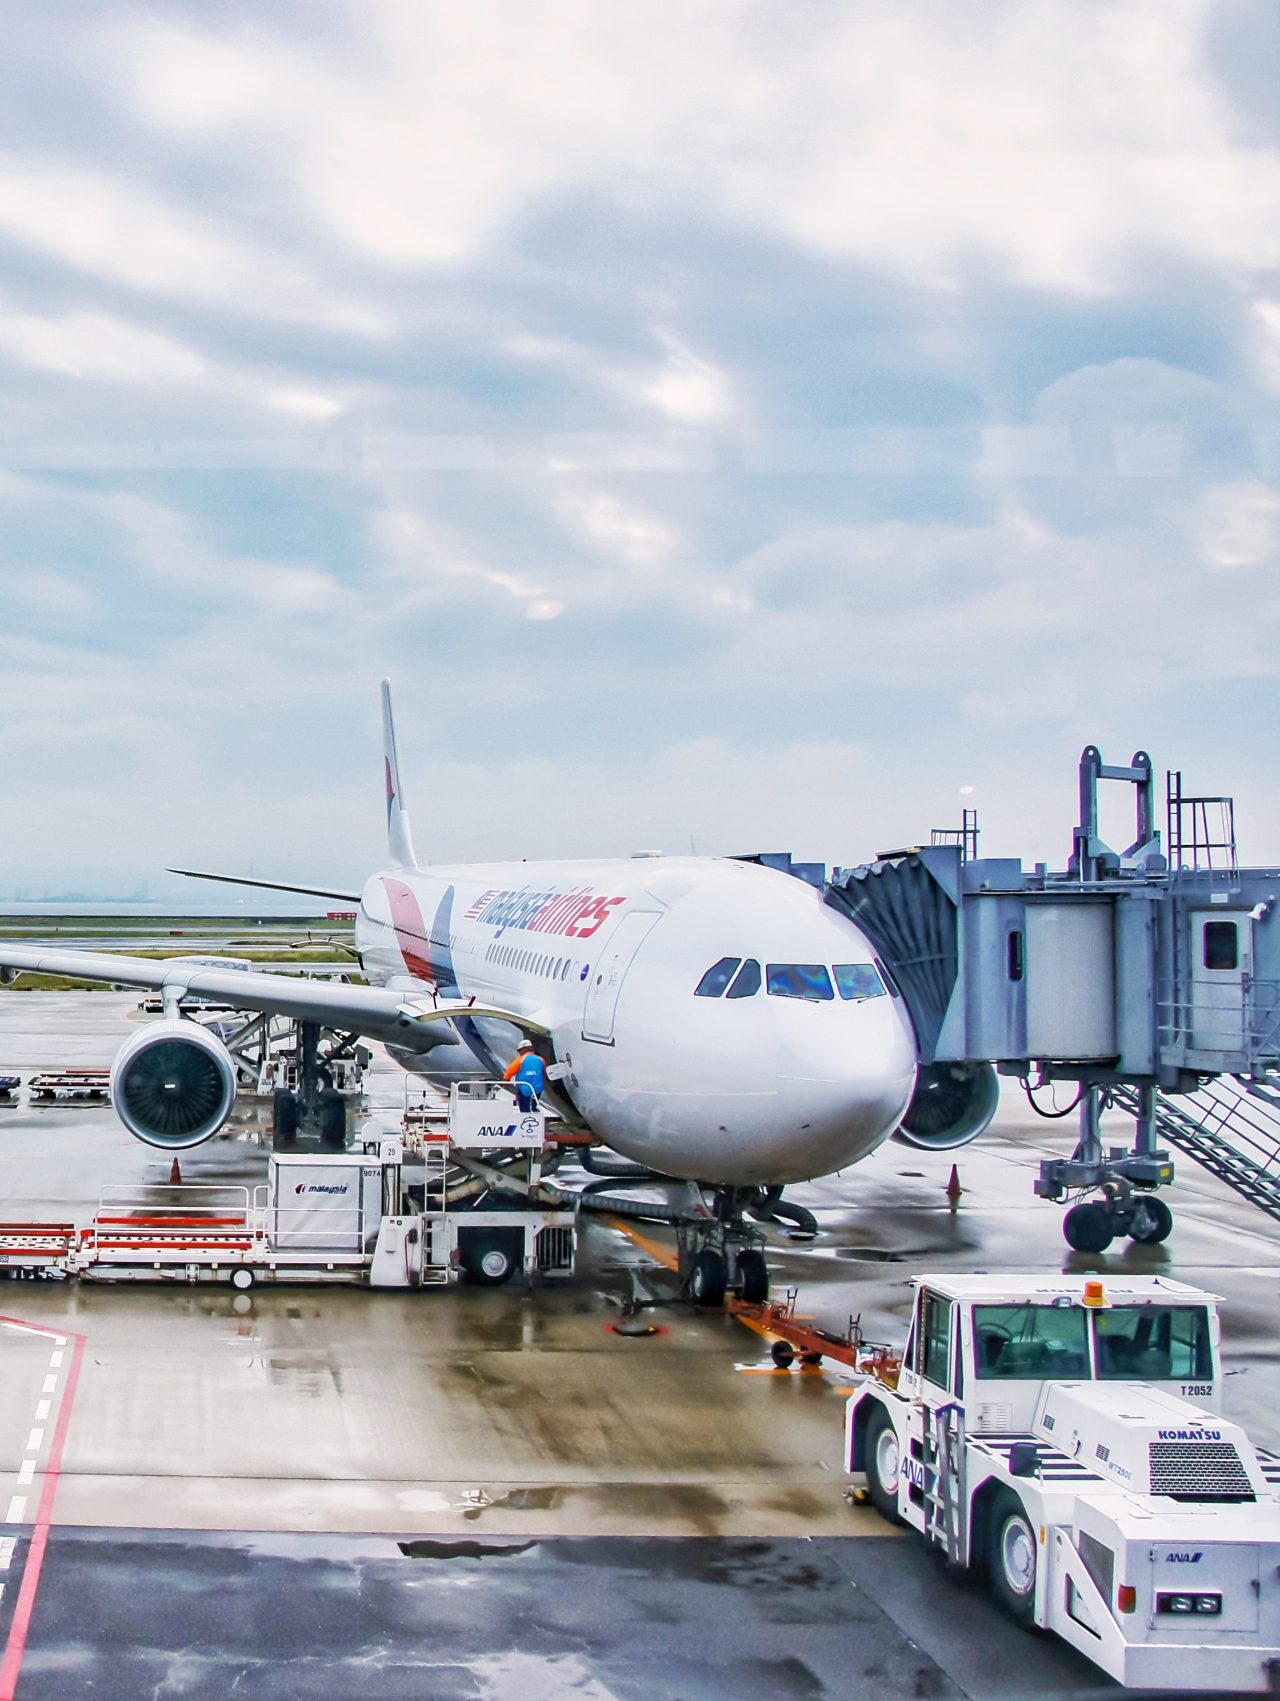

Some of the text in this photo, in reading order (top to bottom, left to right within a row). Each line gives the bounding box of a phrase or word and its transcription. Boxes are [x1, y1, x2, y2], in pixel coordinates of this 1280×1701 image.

[477, 1126, 504, 1137] ANA
[387, 1148, 396, 1156] 29
[308, 1184, 348, 1194] malaysia
[1158, 1428, 1222, 1441] KOMATSU
[900, 1456, 925, 1491] ANA
[1165, 1553, 1190, 1562] ANA
